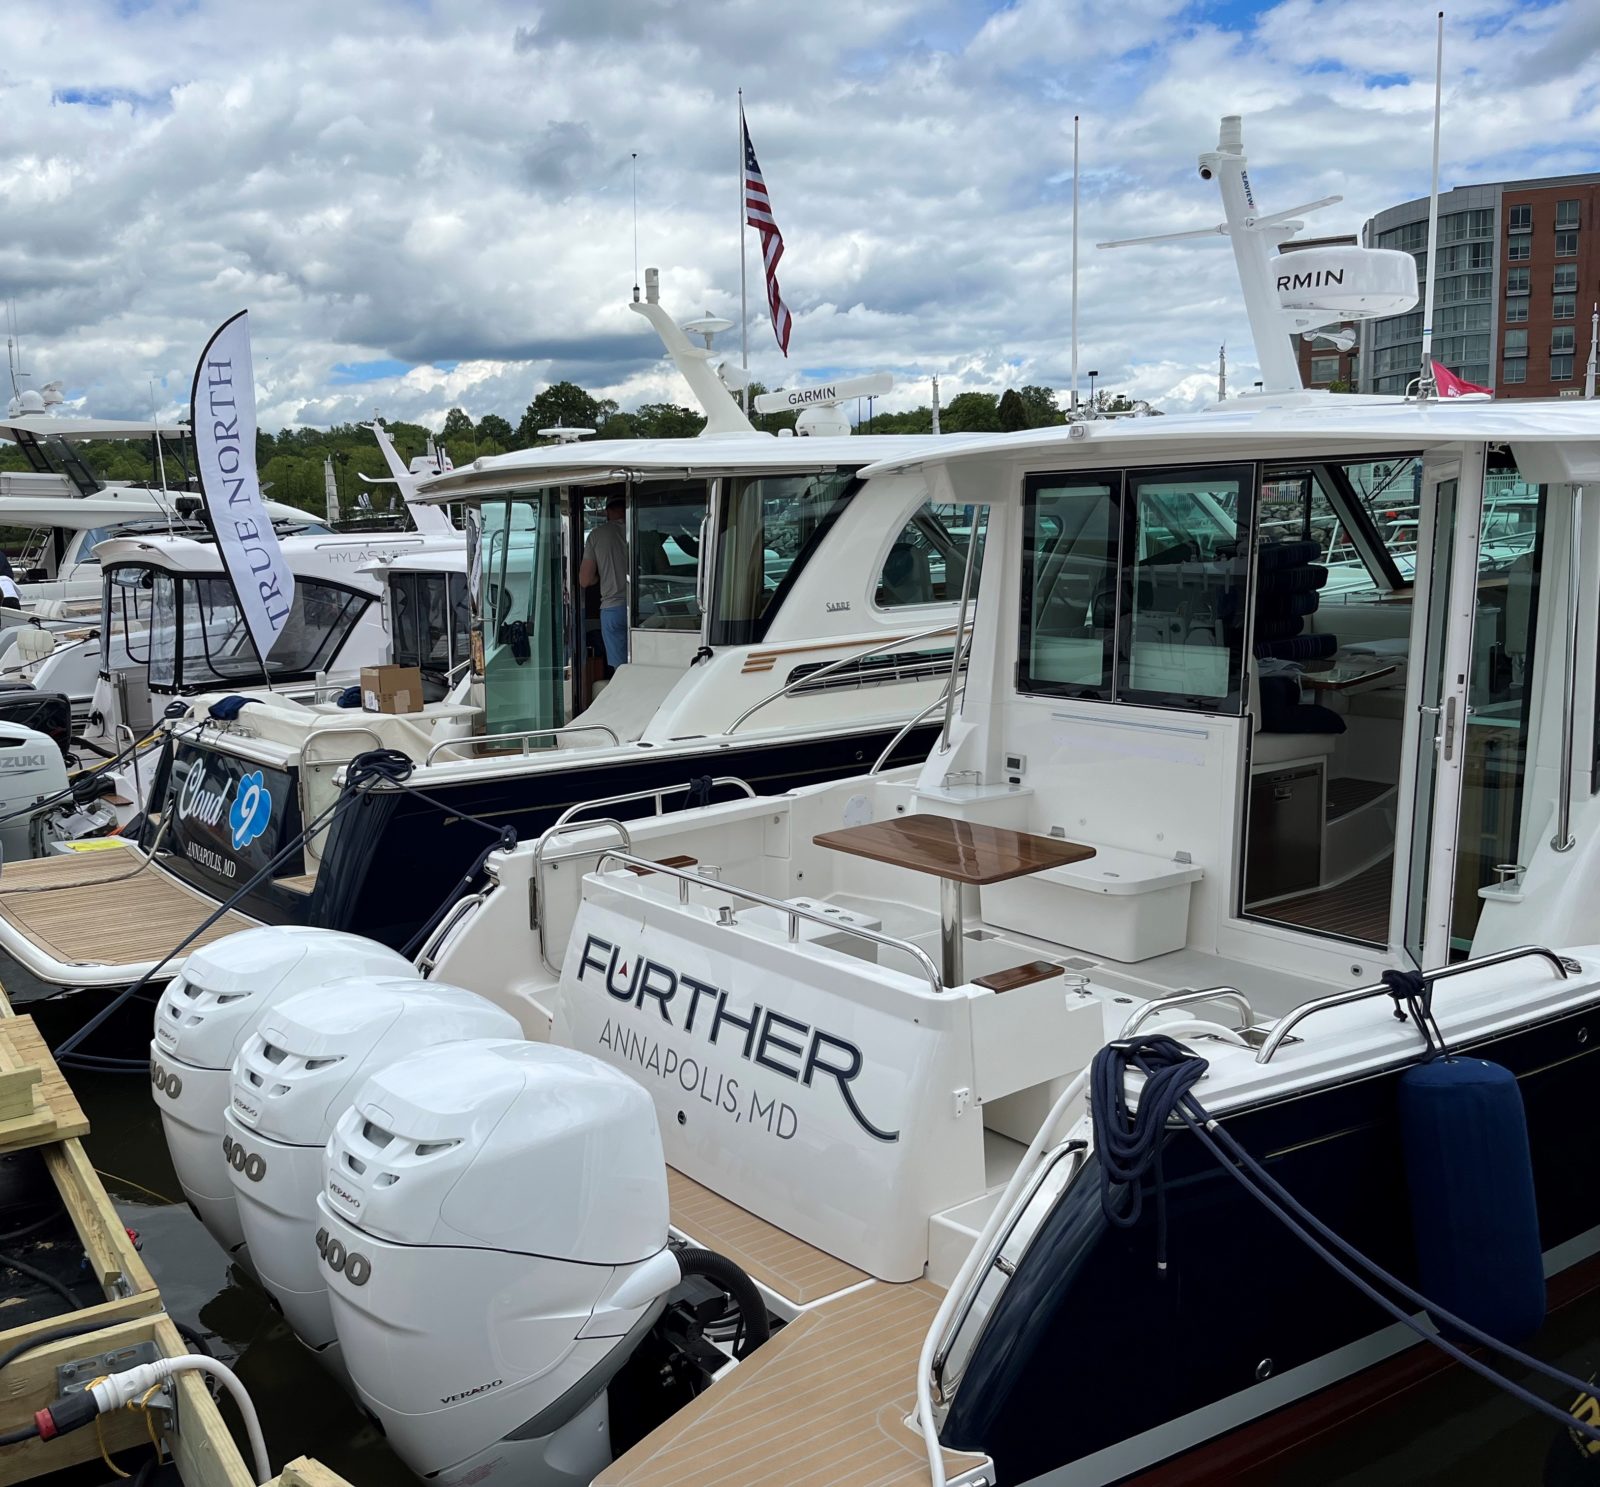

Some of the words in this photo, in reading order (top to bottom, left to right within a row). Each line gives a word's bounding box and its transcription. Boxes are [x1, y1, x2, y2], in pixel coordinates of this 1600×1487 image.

[1240, 170, 1254, 206] SEAVIEW
[1276, 269, 1344, 292] RMIN
[788, 386, 836, 405] GARMIN
[207, 357, 251, 509] NORTH
[234, 517, 290, 631] TRUE
[328, 550, 379, 564] HYLAS
[0, 755, 46, 768] ZUKI
[179, 758, 233, 827] Cloud
[235, 784, 261, 841] 9
[186, 841, 223, 875] ANNAPOLIS,
[222, 858, 237, 878] MD
[576, 933, 900, 1143] FURTHER
[598, 1018, 743, 1123] ANNAPOLIS,
[748, 1090, 798, 1140] MD
[222, 1134, 267, 1183] 400
[315, 1226, 372, 1287] 400
[440, 1379, 504, 1404] VERADO
